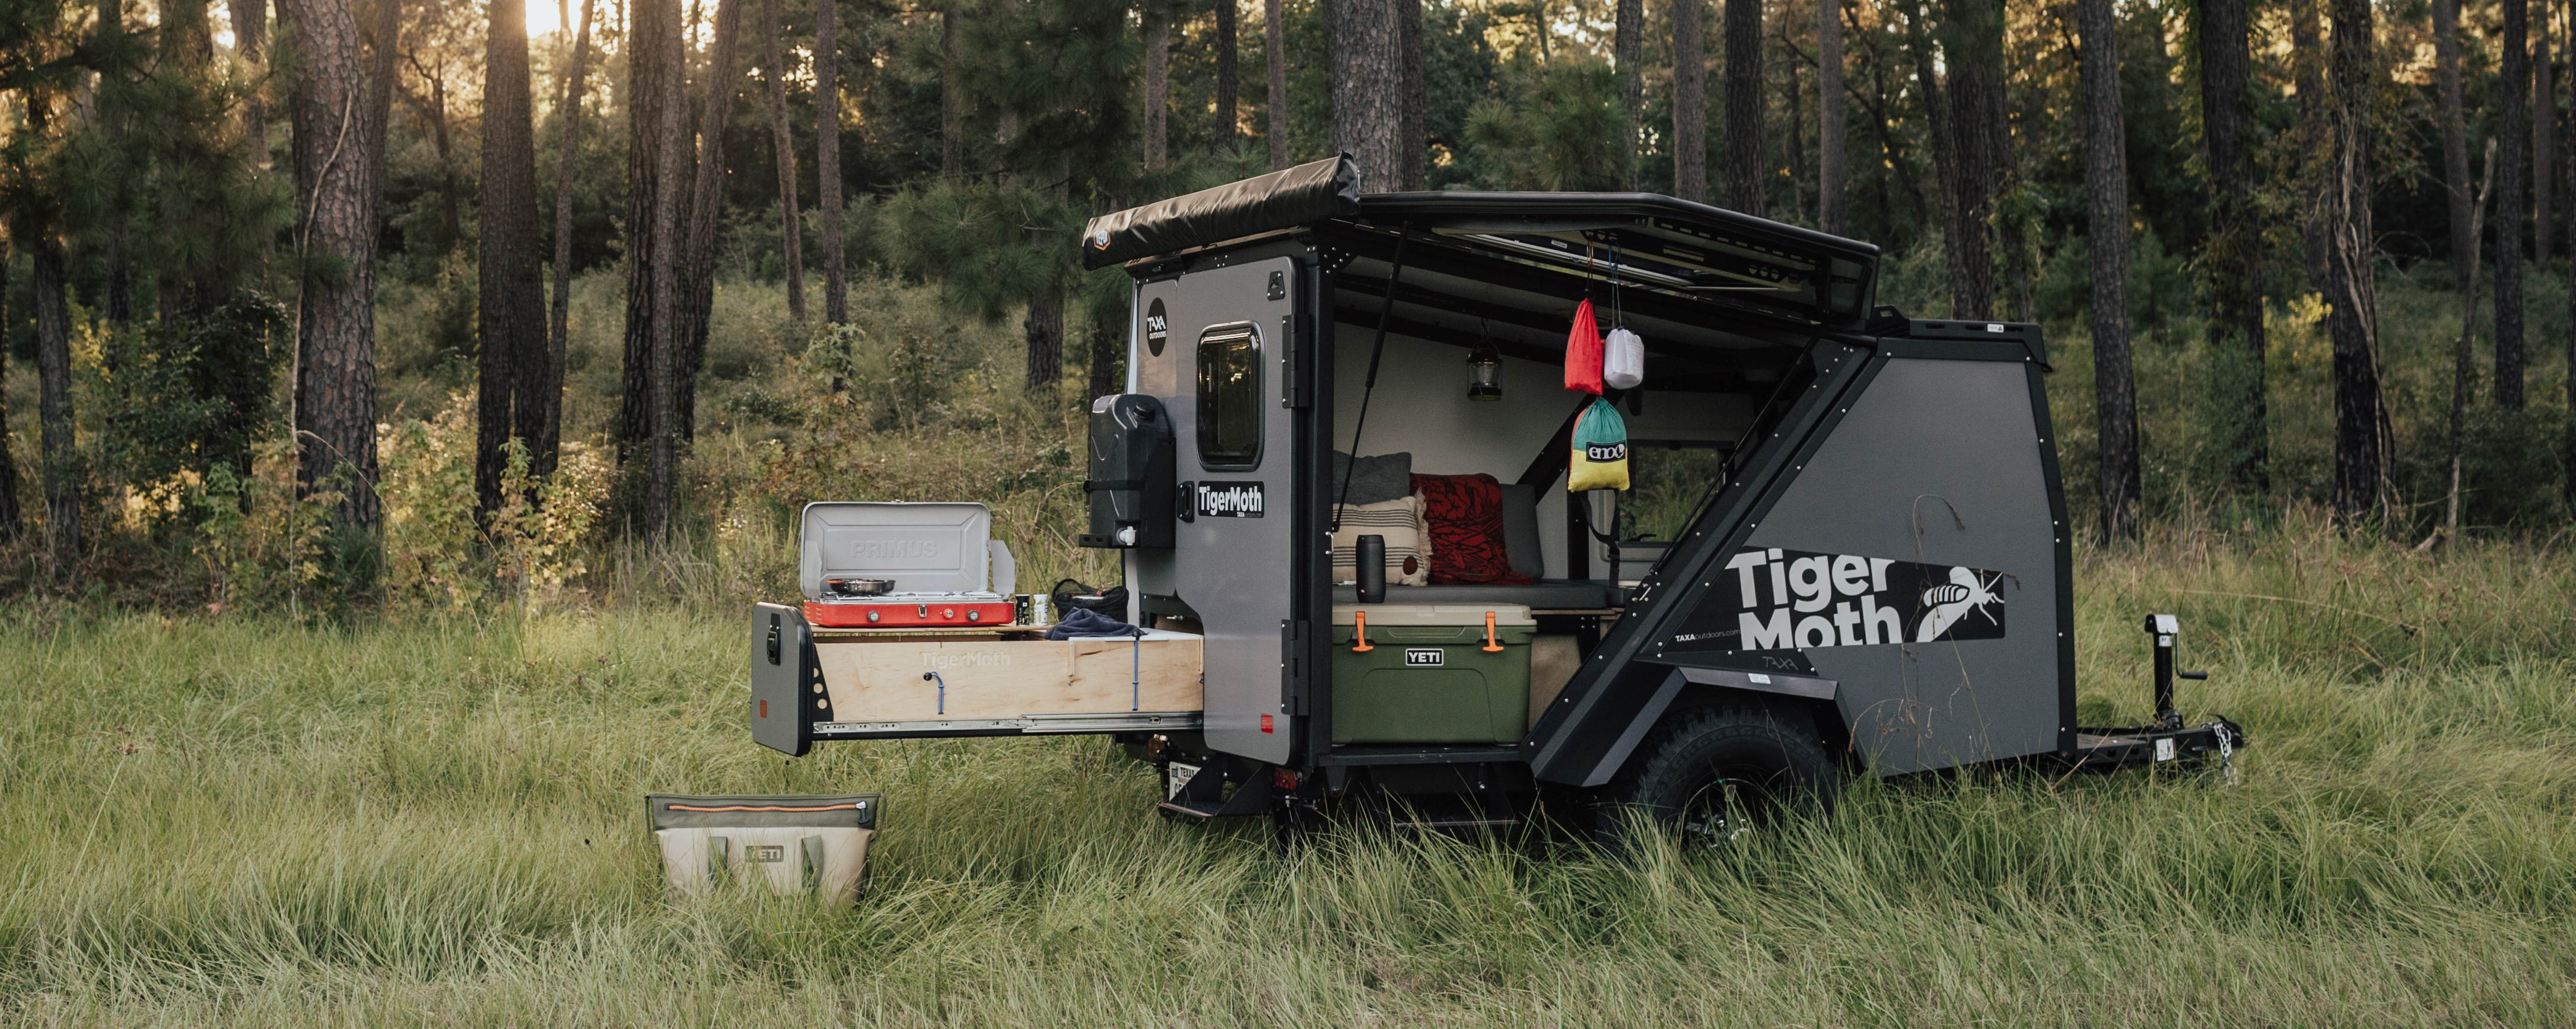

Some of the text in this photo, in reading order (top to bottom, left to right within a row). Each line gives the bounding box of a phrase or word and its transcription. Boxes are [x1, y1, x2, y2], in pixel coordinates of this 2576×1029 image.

[1147, 315, 1166, 332] TAXA
[1199, 485, 1262, 516] TigerMoth
[850, 541, 938, 558] PRIMUS
[1725, 548, 1896, 612] Tiger
[1738, 594, 1902, 650] Moth
[920, 650, 1011, 668] TigerMoth
[1408, 652, 1440, 662] YETI
[1761, 656, 1799, 671] TAXA
[748, 849, 781, 859] YETI
